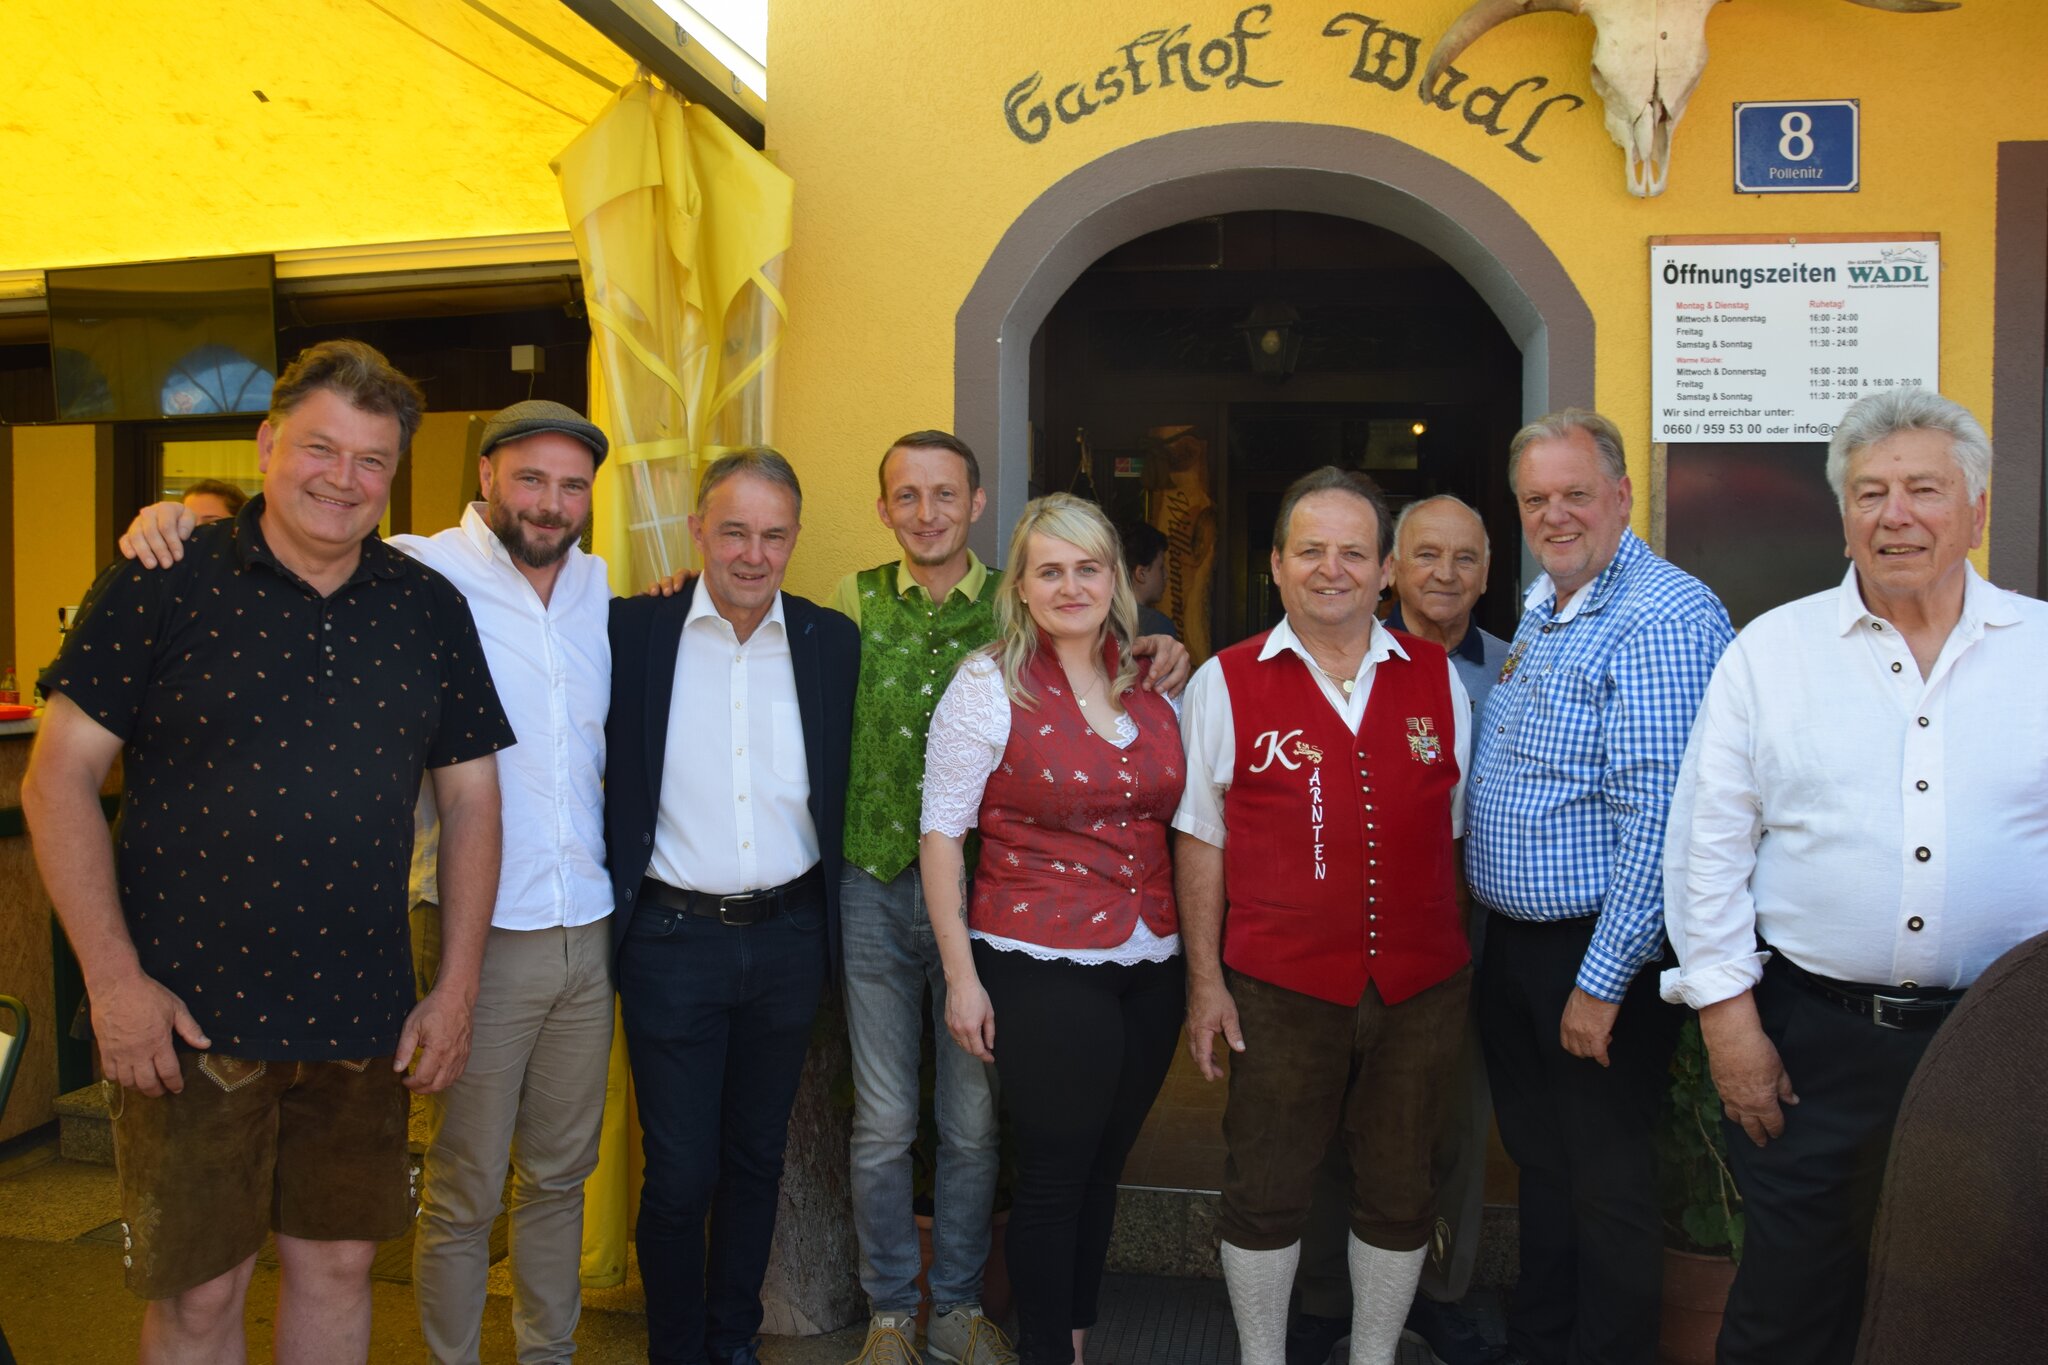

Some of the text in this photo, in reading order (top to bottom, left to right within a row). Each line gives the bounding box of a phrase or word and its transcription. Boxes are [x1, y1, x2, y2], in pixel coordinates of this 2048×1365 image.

[1003, 3, 1584, 164] Gasthof Wadl
[1778, 111, 1814, 161] 8
[1768, 165, 1823, 179] Pollenitz
[1663, 259, 1836, 289] Öffnungszeiten
[1847, 265, 1929, 283] WADL
[1676, 302, 1705, 311] Montag
[1715, 302, 1749, 310] Dienstag
[1809, 300, 1845, 309] Ruhetag!
[1676, 315, 1711, 323] Mittwoch
[1721, 315, 1766, 324] Donnerstag
[1809, 313, 1830, 321] 16:00
[1837, 313, 1858, 321] 24:00
[1676, 328, 1703, 337] Freitag
[1809, 326, 1830, 334] 11:30
[1837, 326, 1858, 334] 24:00
[1676, 341, 1710, 350] Samstag
[1720, 340, 1752, 349] Sonntag
[1809, 339, 1830, 347] 11:30
[1837, 339, 1858, 347] 24:00
[1676, 368, 1711, 376] Mittwoch
[1721, 368, 1766, 377] Donnerstag
[1809, 366, 1830, 374] 16:00
[1837, 366, 1858, 374] 20:00
[1676, 380, 1704, 389] Freitag
[1809, 379, 1830, 387] 11:30
[1837, 379, 1858, 387] 14:00
[1862, 379, 1868, 387] &
[1676, 393, 1710, 402] Samstag
[1720, 392, 1752, 402] Sonntag
[1809, 392, 1830, 400] 11:30
[1837, 392, 1858, 400] 20:00
[1663, 408, 1795, 417] Wir sind erreichbar unter:
[1663, 424, 1692, 434] 0660
[1703, 424, 1725, 434] 959
[1729, 424, 1744, 434] 53
[1747, 424, 1762, 434] 00
[1766, 425, 1789, 434] oder
[1793, 423, 1839, 437] info@g
